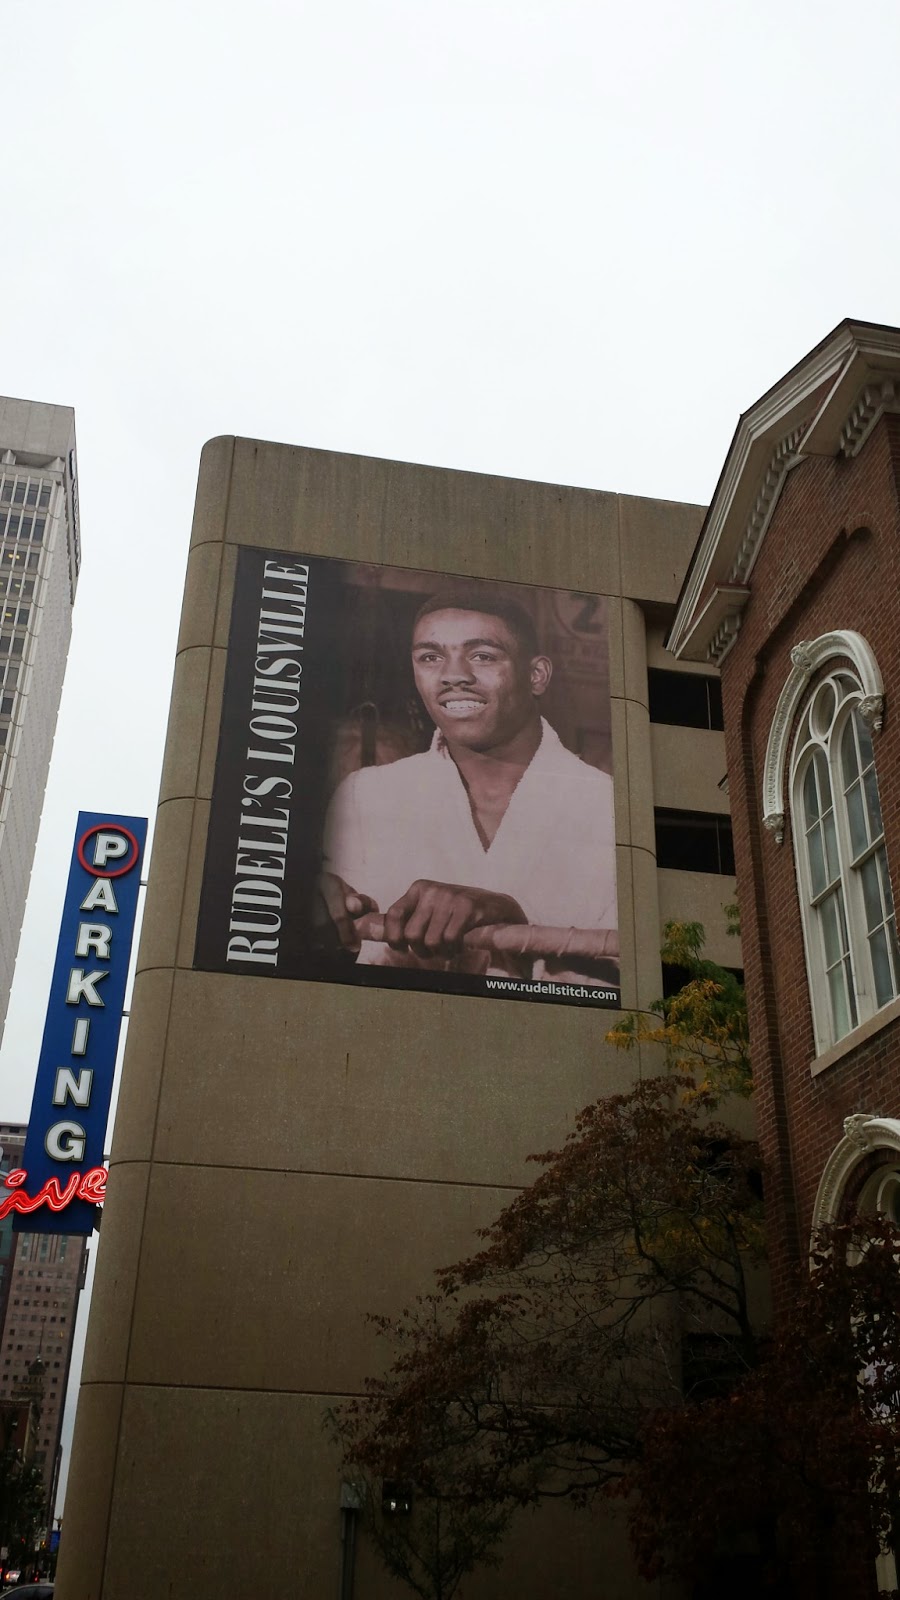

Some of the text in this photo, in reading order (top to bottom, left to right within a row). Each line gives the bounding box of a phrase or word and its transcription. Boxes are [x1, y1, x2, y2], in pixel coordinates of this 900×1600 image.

[226, 560, 310, 966] RUDELL'S LOUISVILLE
[44, 832, 129, 1163] PARKING
[486, 980, 617, 1001] www.rudellstitch.com
[0, 1165, 109, 1219] ive
